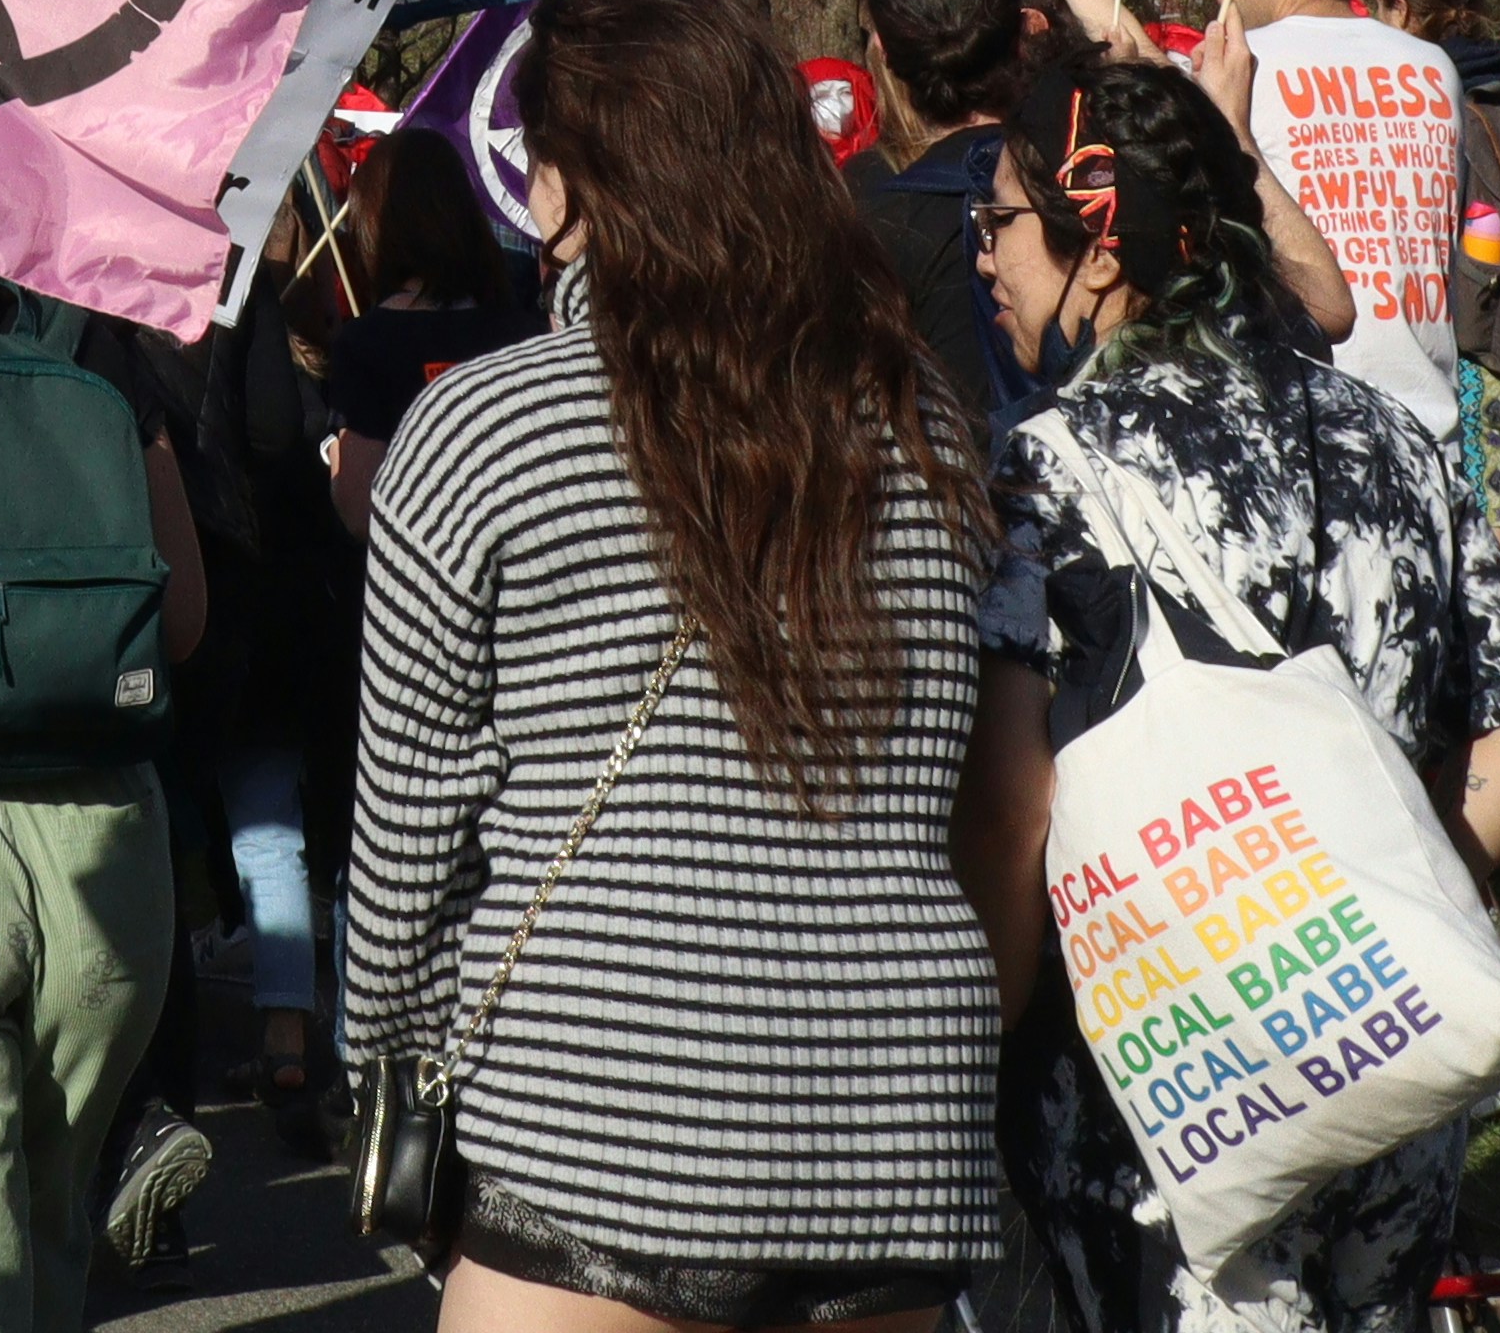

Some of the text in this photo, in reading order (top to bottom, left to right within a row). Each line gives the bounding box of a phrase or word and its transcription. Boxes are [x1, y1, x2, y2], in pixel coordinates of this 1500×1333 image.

[1276, 63, 1453, 120] UNLESS
[1287, 120, 1457, 148] SOMEONE LIKE YOU
[1291, 143, 1456, 173] CARES A WHOLE
[1298, 171, 1408, 210] AWFUL
[1392, 209, 1409, 233] IS
[1344, 237, 1392, 266] GET
[1396, 236, 1449, 266] BETTE
[1403, 270, 1454, 324] NO
[1049, 764, 1292, 928] OCAL BABE
[1162, 808, 1319, 918] BABE
[1076, 850, 1348, 1044] LOCAL BABE
[1100, 893, 1377, 1091] LOCAL BABE
[1128, 938, 1408, 1138] LOCAL BABE
[1157, 984, 1443, 1185] LOCAL BABE
